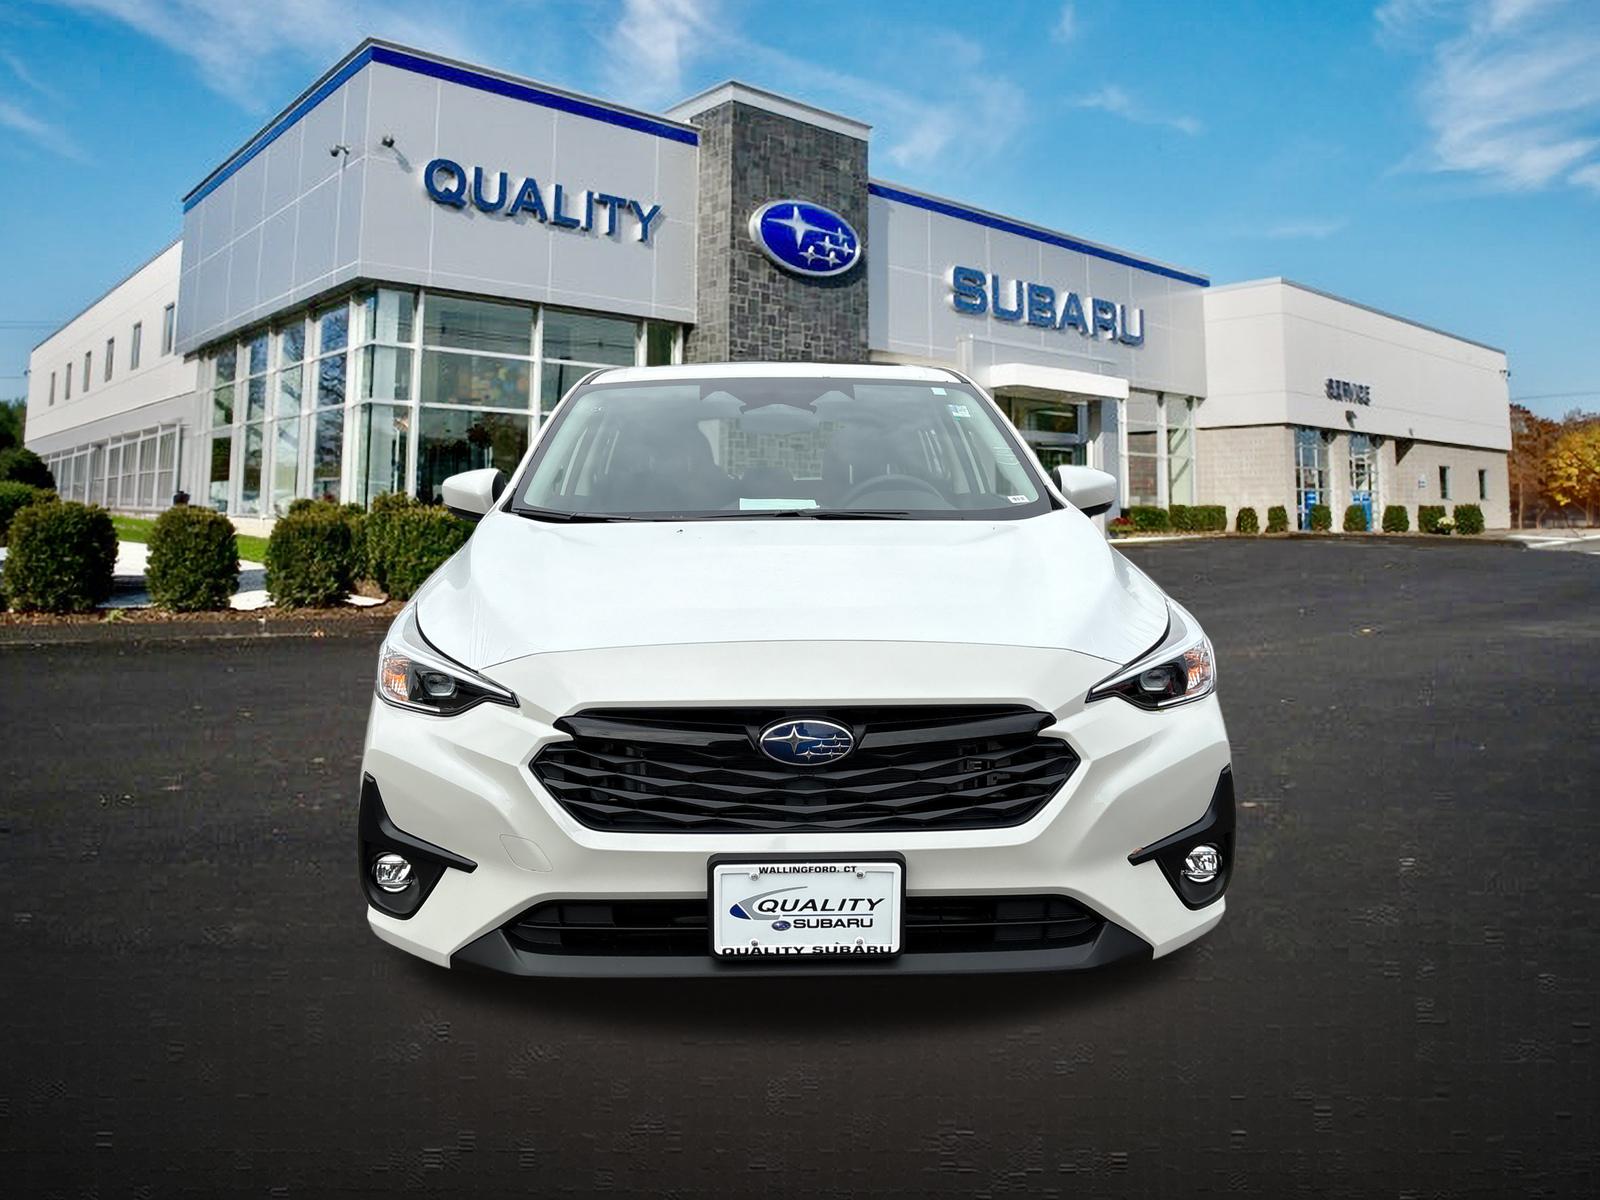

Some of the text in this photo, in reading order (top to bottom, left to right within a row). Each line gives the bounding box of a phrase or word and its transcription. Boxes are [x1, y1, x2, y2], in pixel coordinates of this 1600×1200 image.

[424, 158, 660, 242] QUALITY
[952, 265, 1145, 347] SUBARU
[1325, 377, 1371, 406] SERVICE
[843, 865, 857, 873] CT
[757, 898, 885, 913] QUALITY
[793, 918, 873, 929] SUBARU
[722, 945, 892, 955] QUALITY SUBARU
